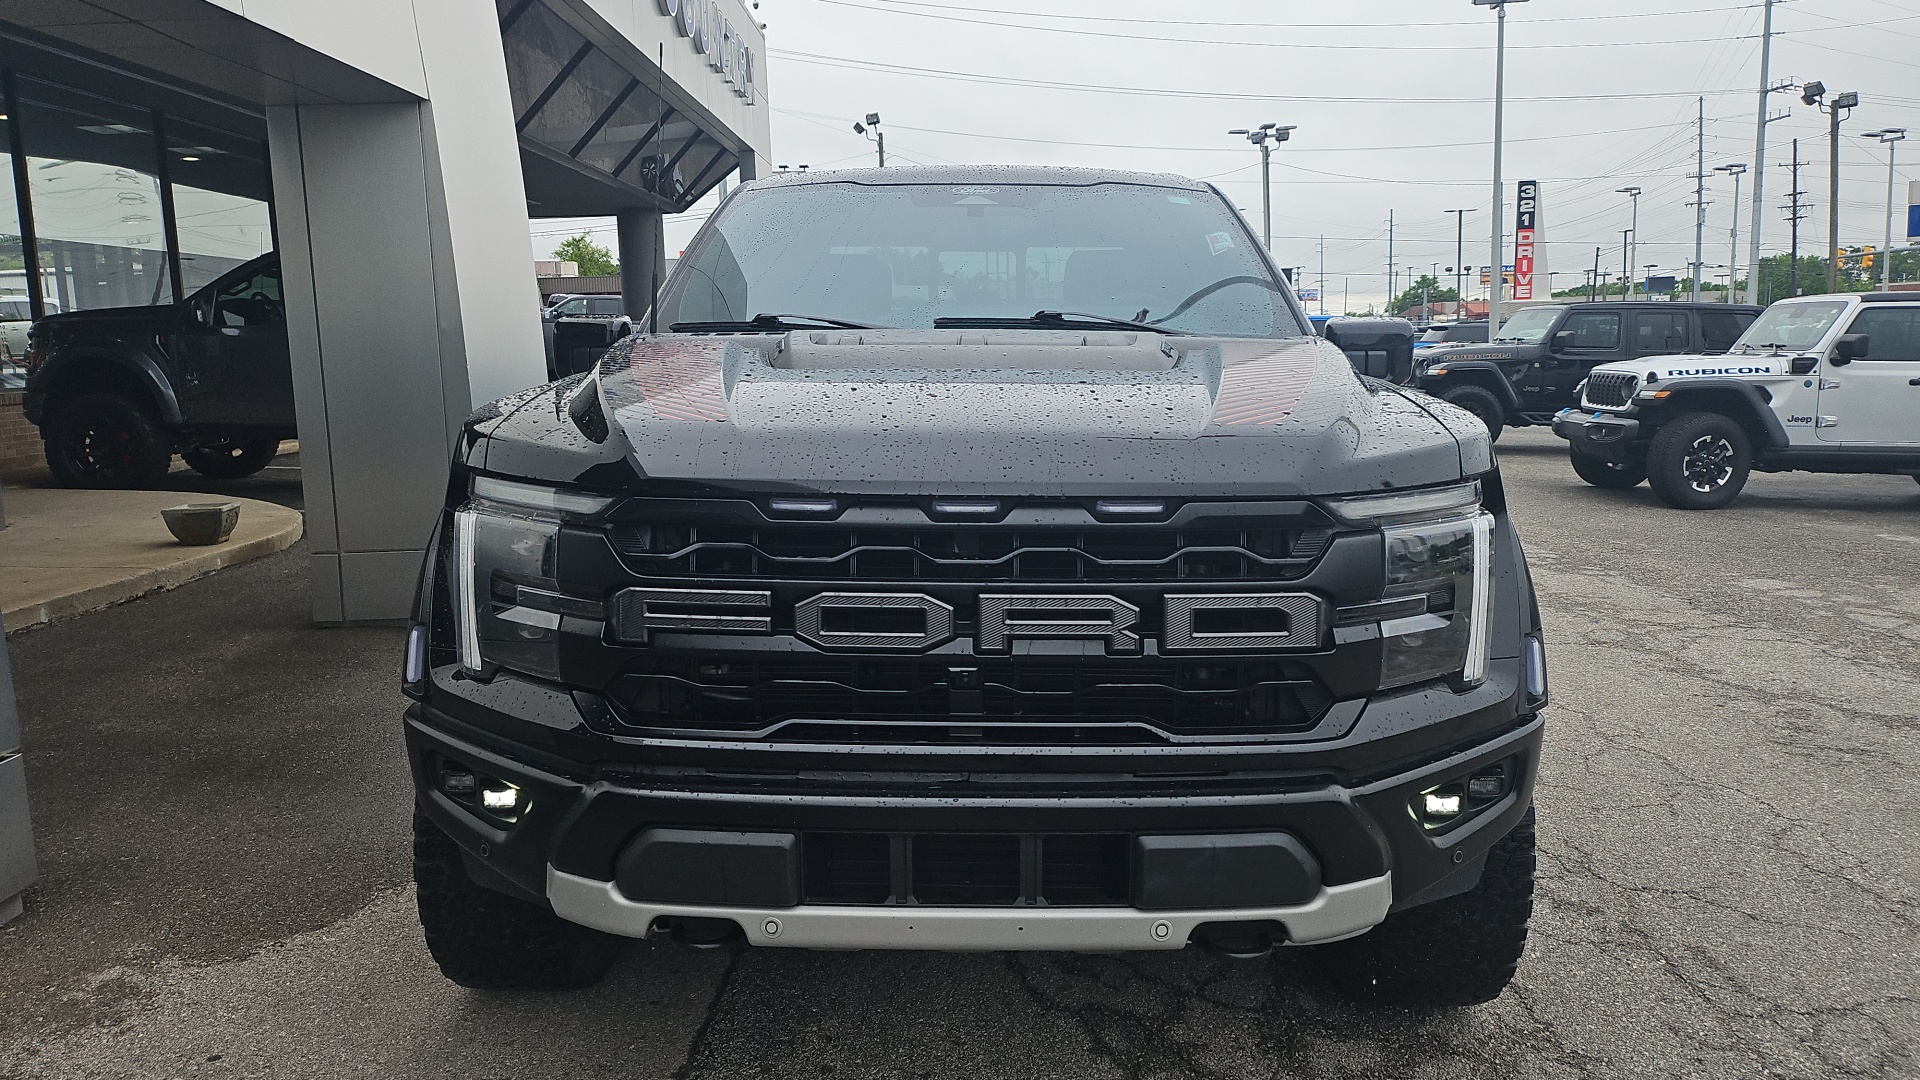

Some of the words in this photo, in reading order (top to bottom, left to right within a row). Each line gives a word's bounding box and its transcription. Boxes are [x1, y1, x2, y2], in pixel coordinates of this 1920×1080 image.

[660, 0, 755, 106] OUNTRY
[1519, 184, 1536, 226] 321
[1516, 231, 1534, 298] DRIVE
[1668, 366, 1771, 377] RUBICON
[1786, 414, 1813, 424] Jeep
[615, 587, 1323, 651] FORD
